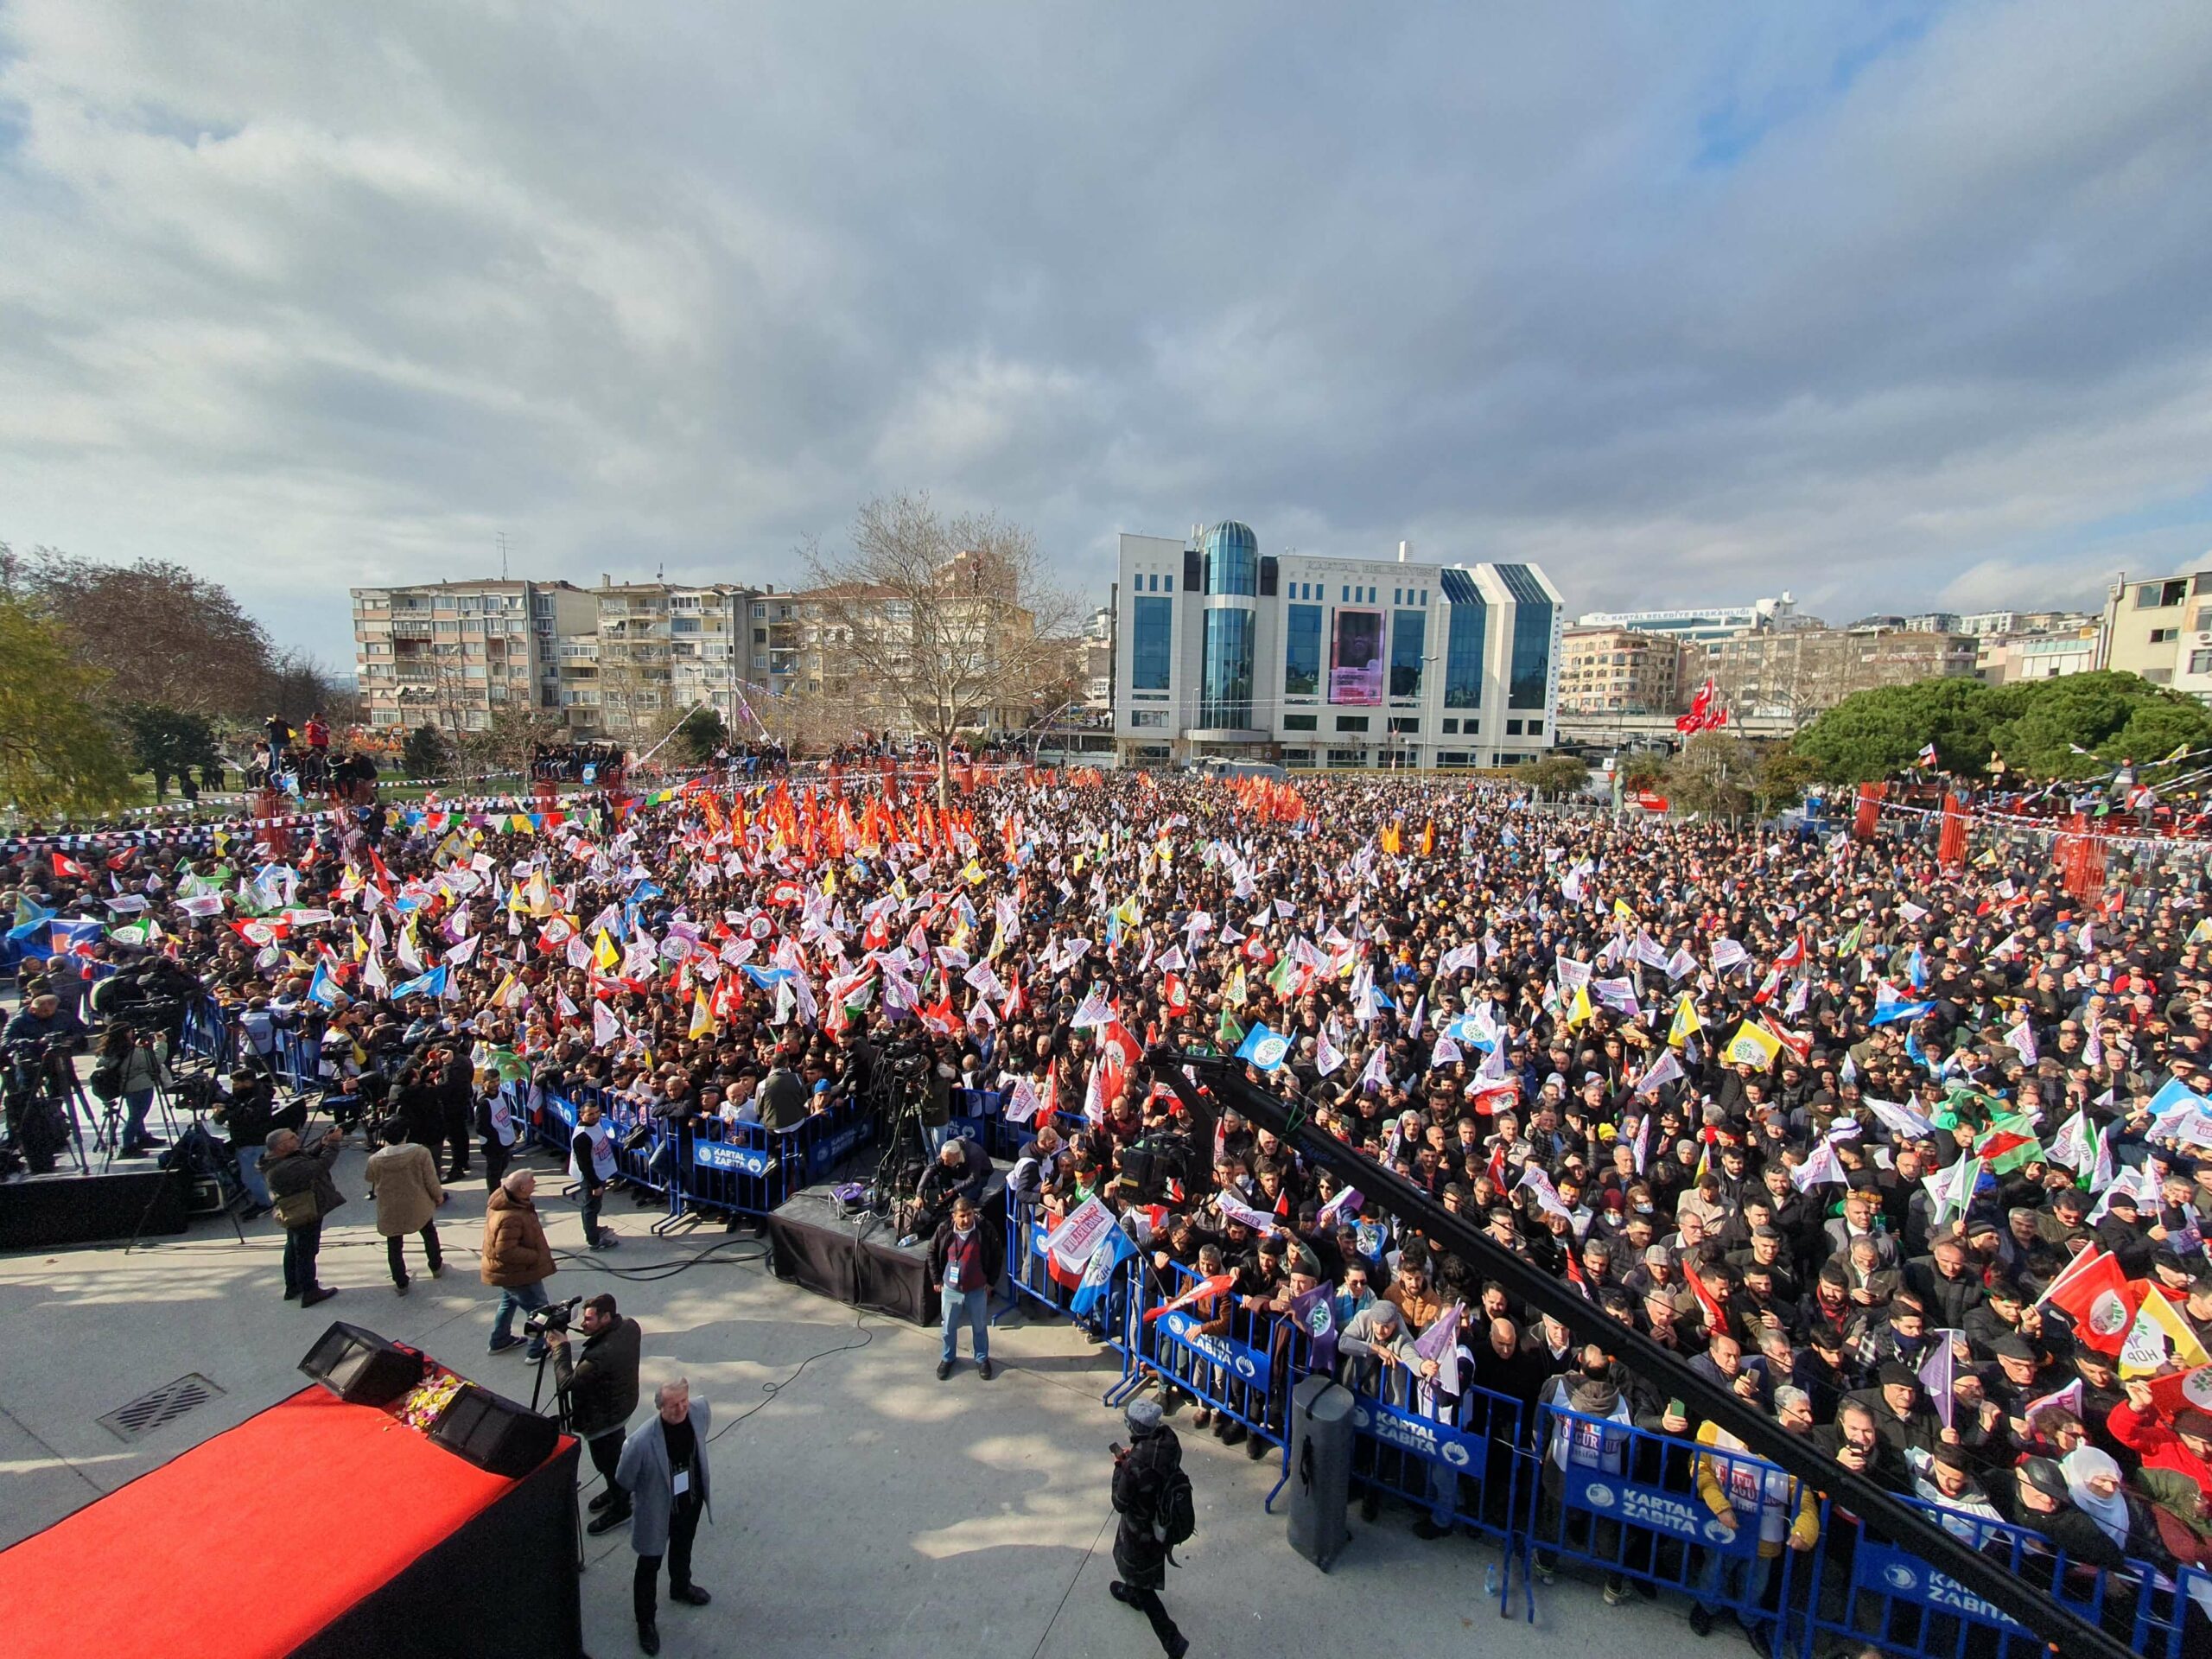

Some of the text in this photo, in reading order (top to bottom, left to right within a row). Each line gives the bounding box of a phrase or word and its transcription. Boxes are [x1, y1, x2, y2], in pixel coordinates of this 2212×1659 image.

[1306, 560, 1358, 573] KARTAL
[1611, 613, 1643, 621] KARTAL
[713, 1147, 746, 1160] KARTAL
[1192, 1336, 1232, 1367] ABITA
[1375, 1422, 1437, 1456] ZABITA
[1376, 1410, 1438, 1442] KARTAL
[1622, 1502, 1697, 1535] ZABITA
[1623, 1489, 1699, 1521] KARTAL
